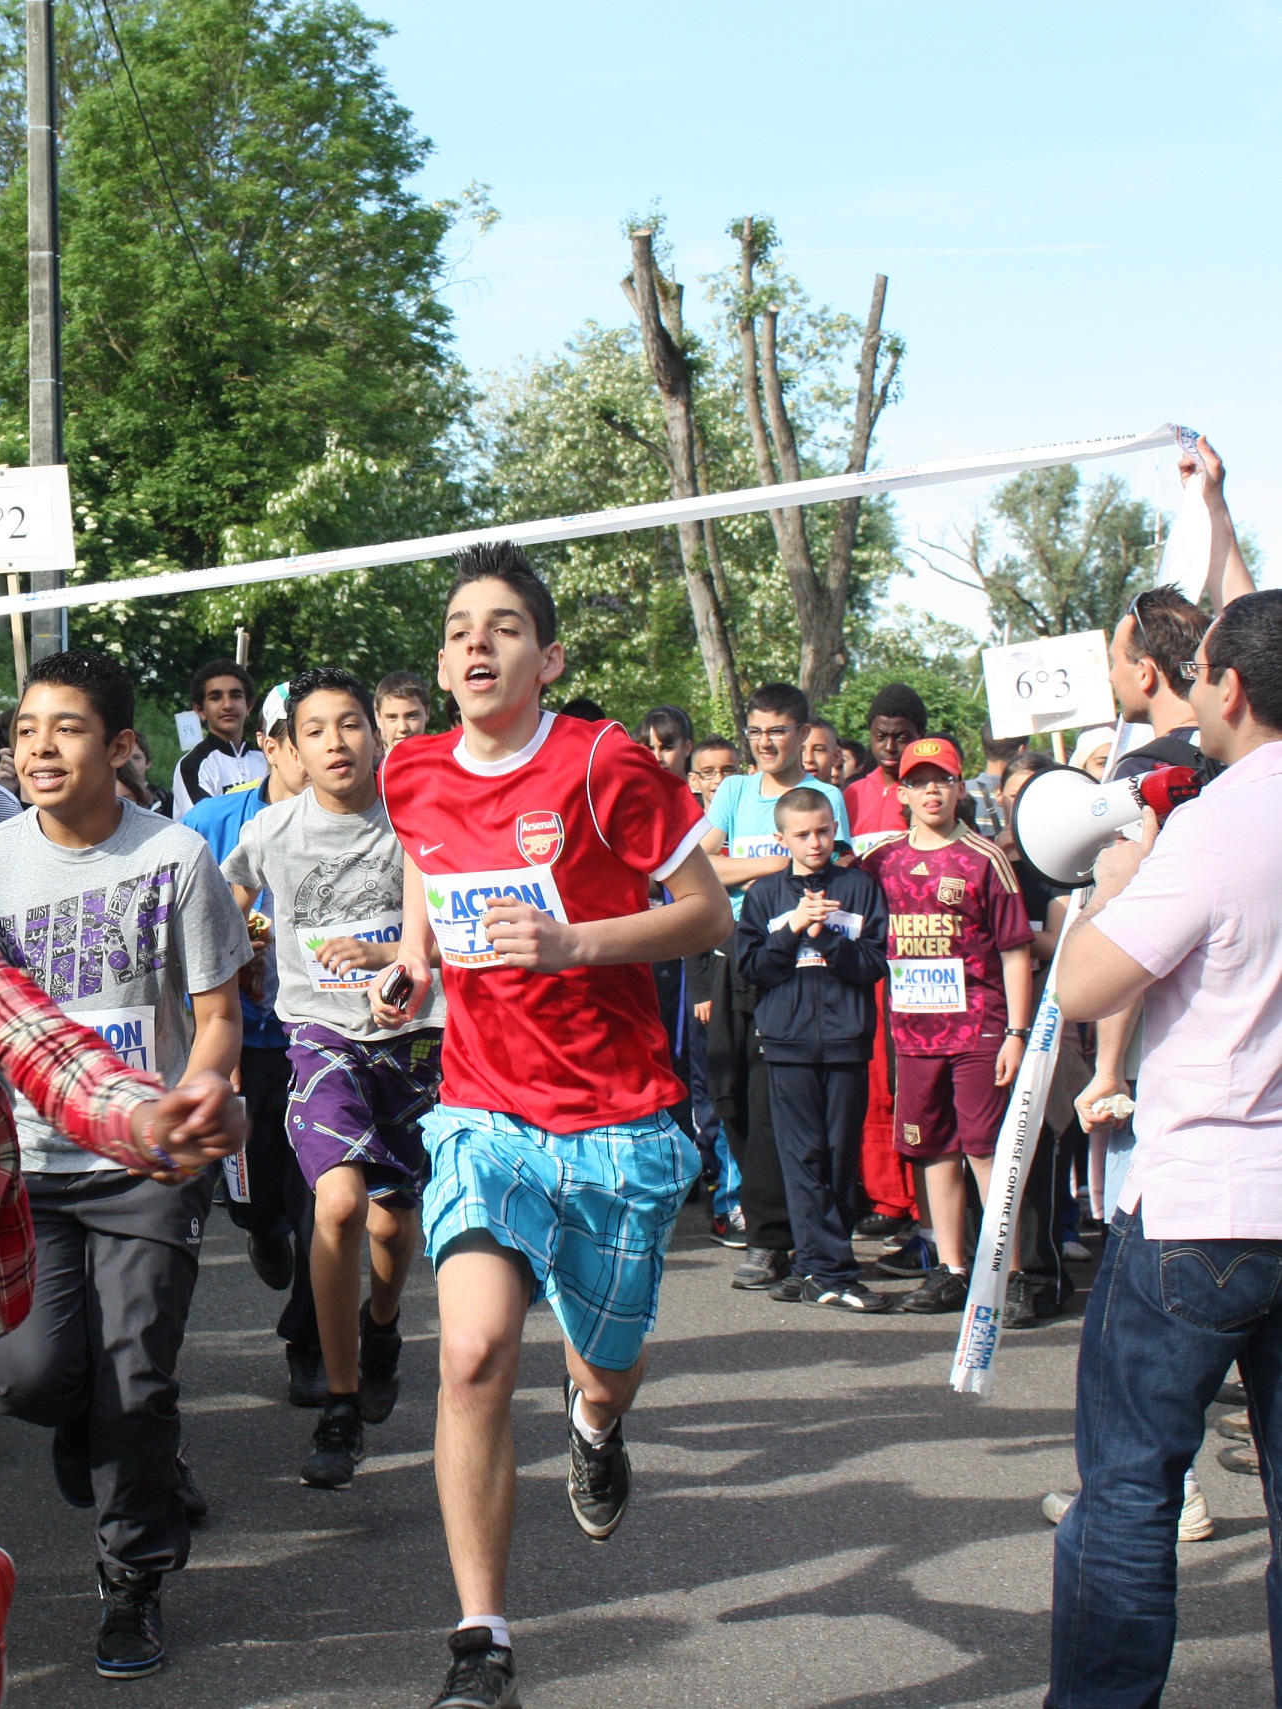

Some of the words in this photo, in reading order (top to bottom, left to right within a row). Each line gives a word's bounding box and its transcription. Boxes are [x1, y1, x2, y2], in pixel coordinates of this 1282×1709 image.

[1016, 669, 1071, 699] 6°3
[522, 819, 555, 832] Arsenal
[905, 968, 956, 984] ACTION
[907, 985, 959, 1003] FAIM
[1039, 1005, 1060, 1053] ACTION
[1021, 1091, 1032, 1106] LA
[1011, 1111, 1028, 1164] COURSE
[1001, 1167, 1021, 1219] CONTRE
[997, 1222, 1009, 1239] LA
[991, 1243, 1005, 1272] FAIM
[965, 1321, 987, 1369] FAIM
[979, 1323, 998, 1370] ACTION
